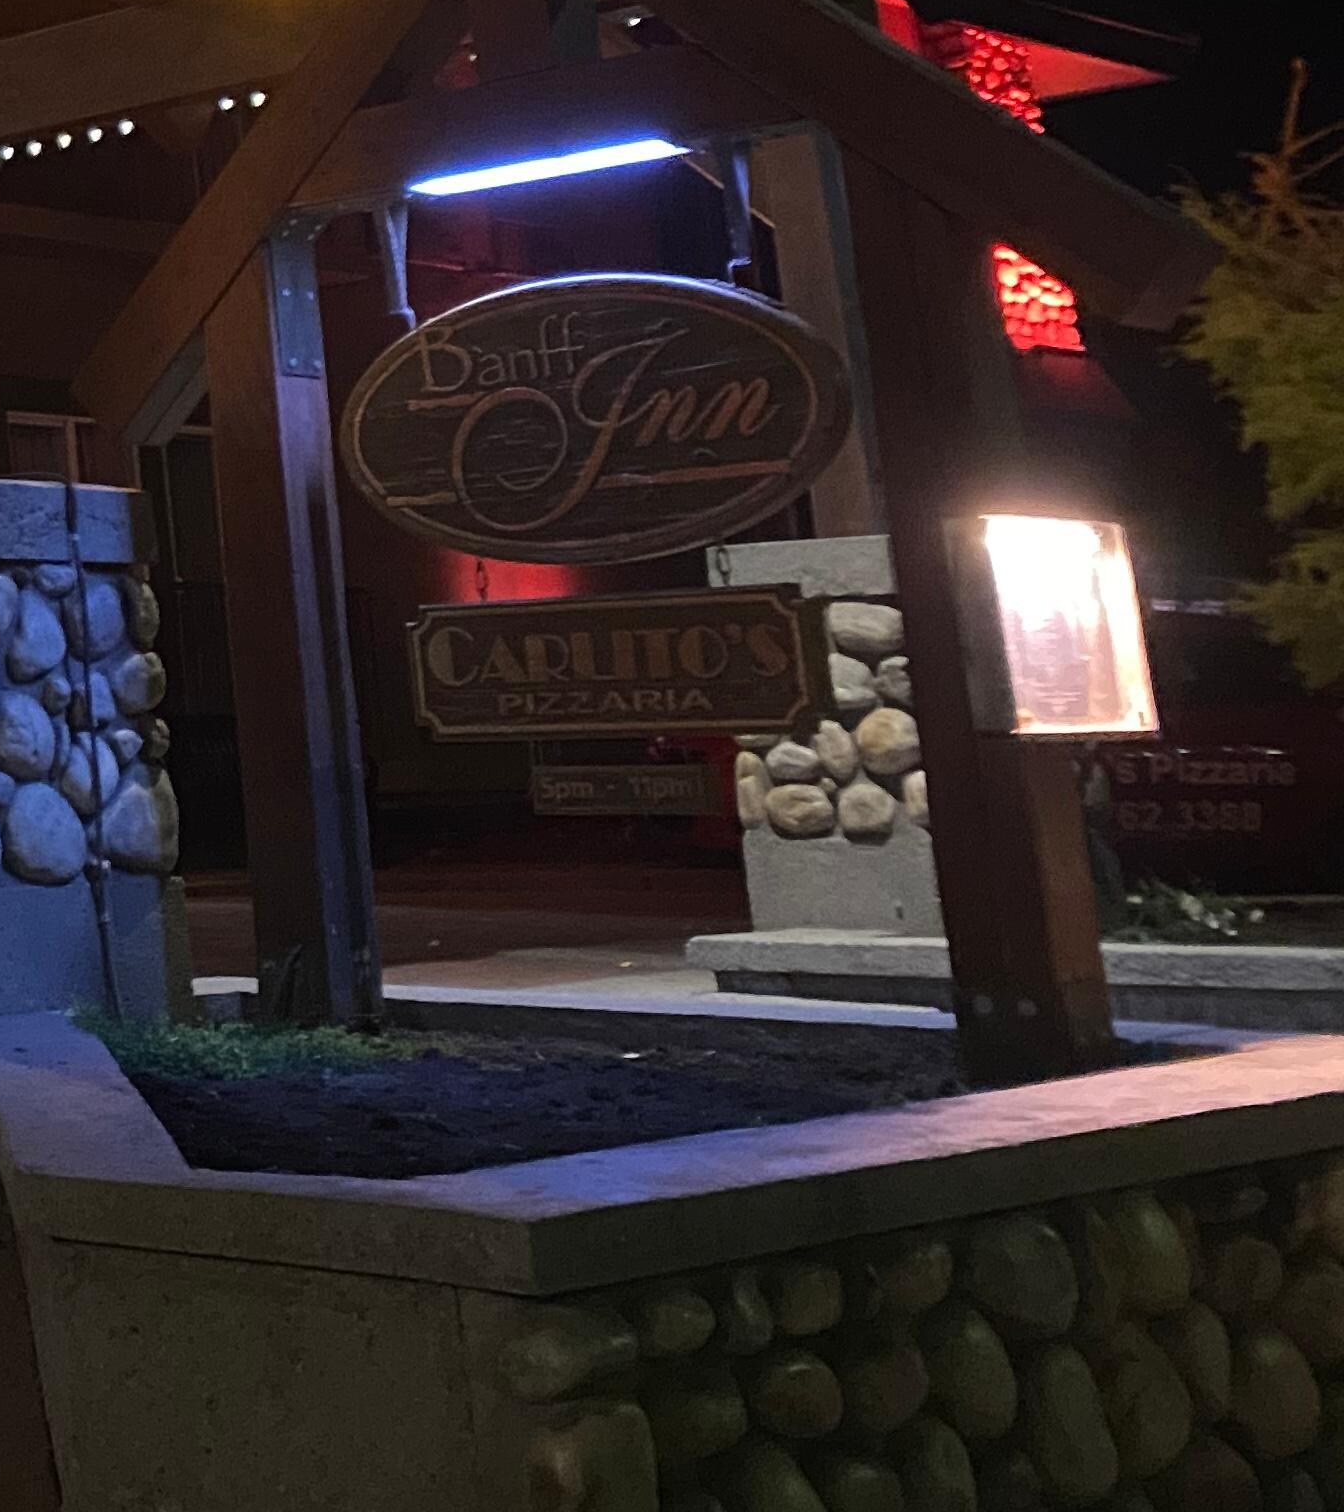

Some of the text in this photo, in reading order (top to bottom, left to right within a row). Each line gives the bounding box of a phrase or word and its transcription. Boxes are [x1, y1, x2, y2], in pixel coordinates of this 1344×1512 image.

[413, 311, 585, 391] Banff
[451, 326, 782, 533] Inn
[426, 624, 789, 686] CARLITO'S
[497, 687, 713, 716] PIZZARIA
